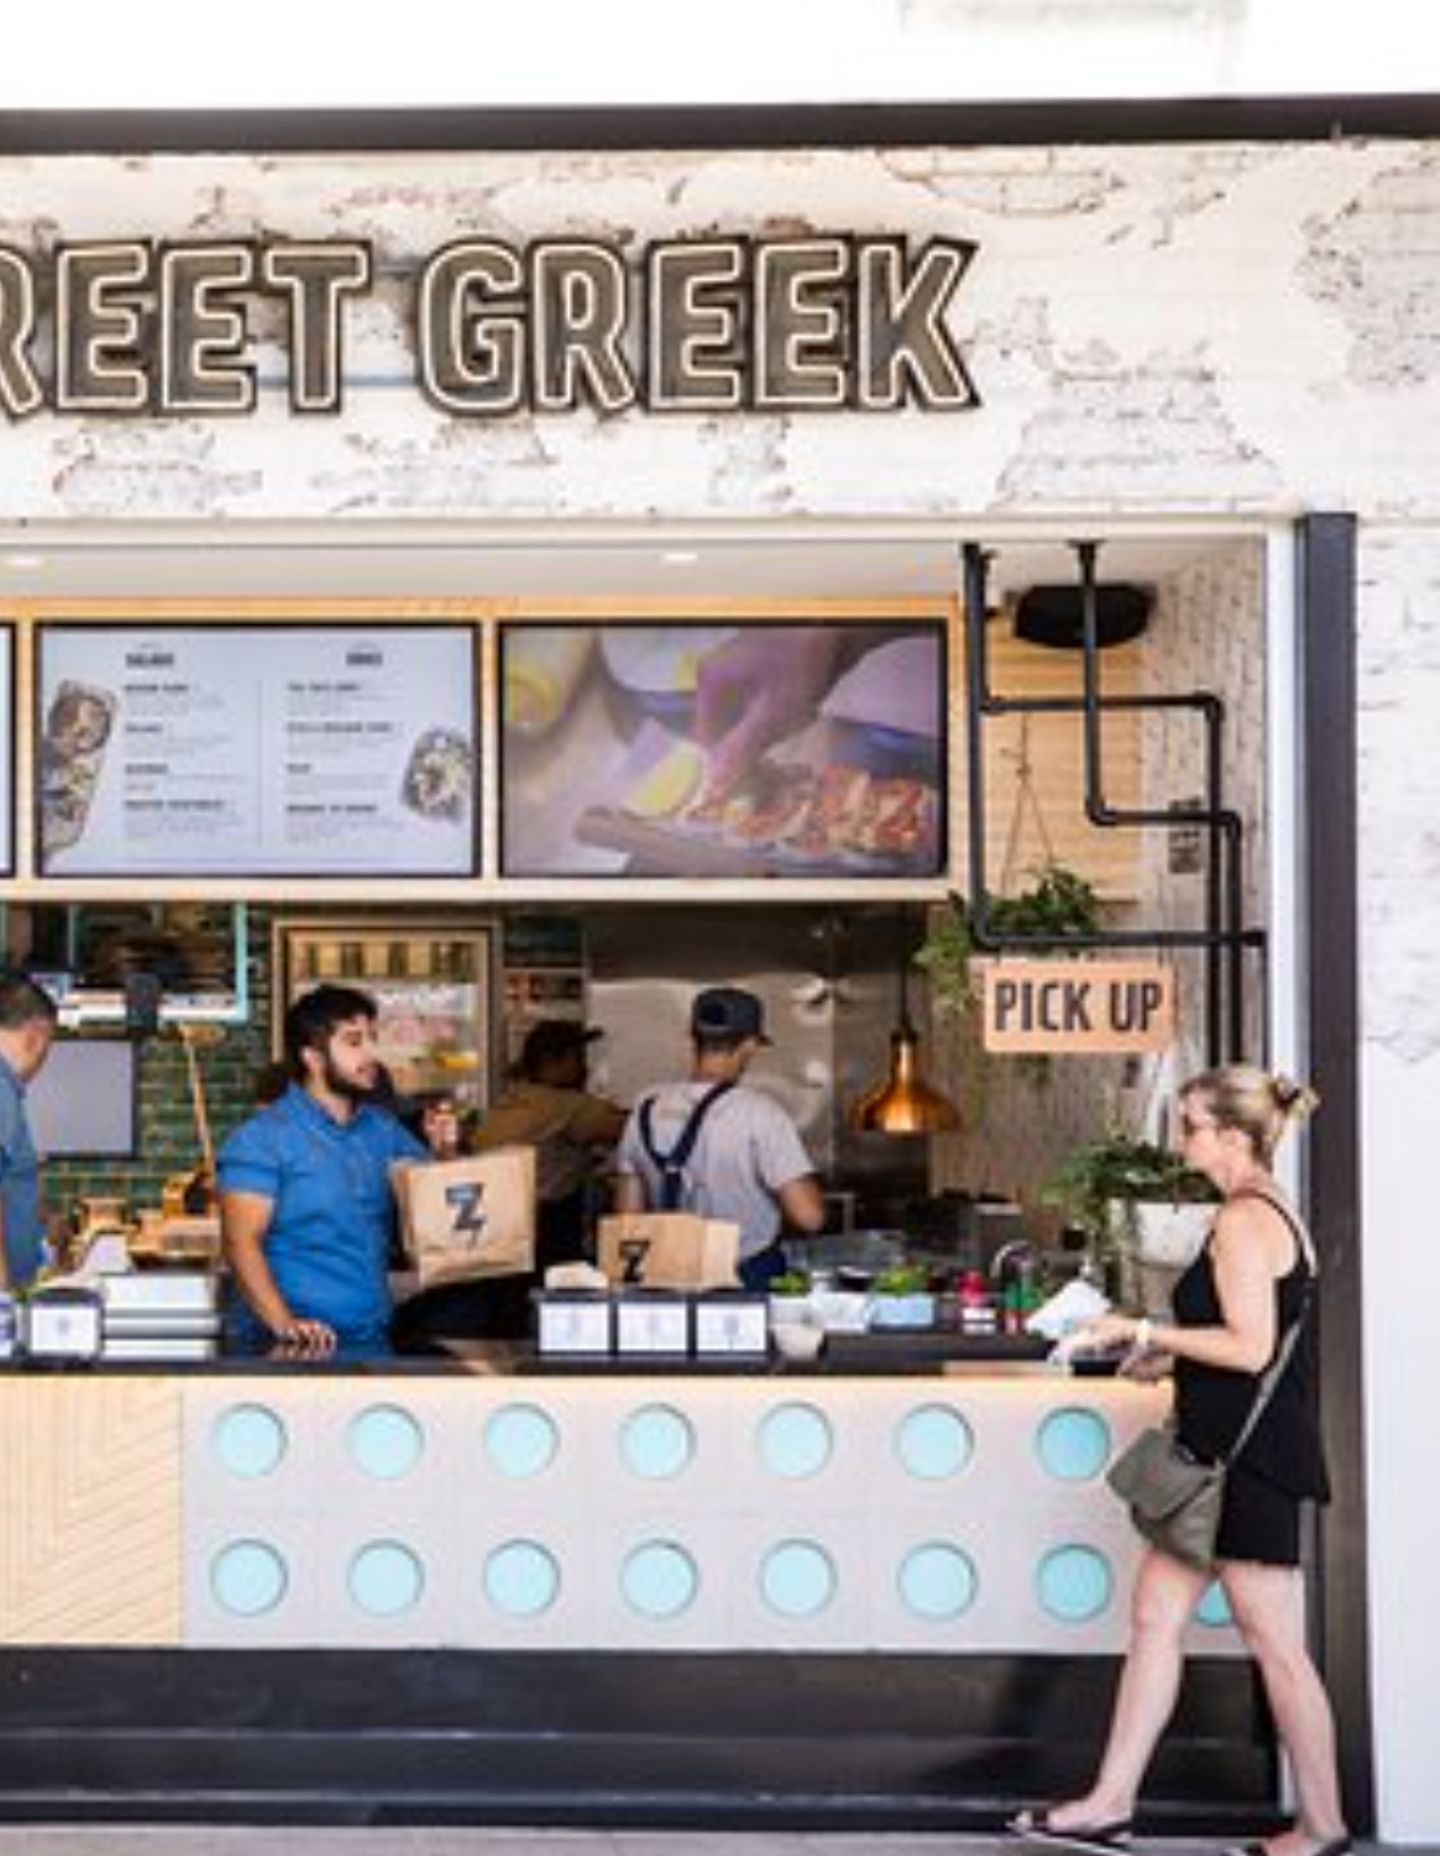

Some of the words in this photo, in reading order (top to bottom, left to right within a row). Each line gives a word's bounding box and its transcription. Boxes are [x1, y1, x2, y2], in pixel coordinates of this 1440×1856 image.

[414, 232, 982, 414] GREEK
[994, 979, 1091, 1033] PICK
[1110, 979, 1163, 1033] UP
